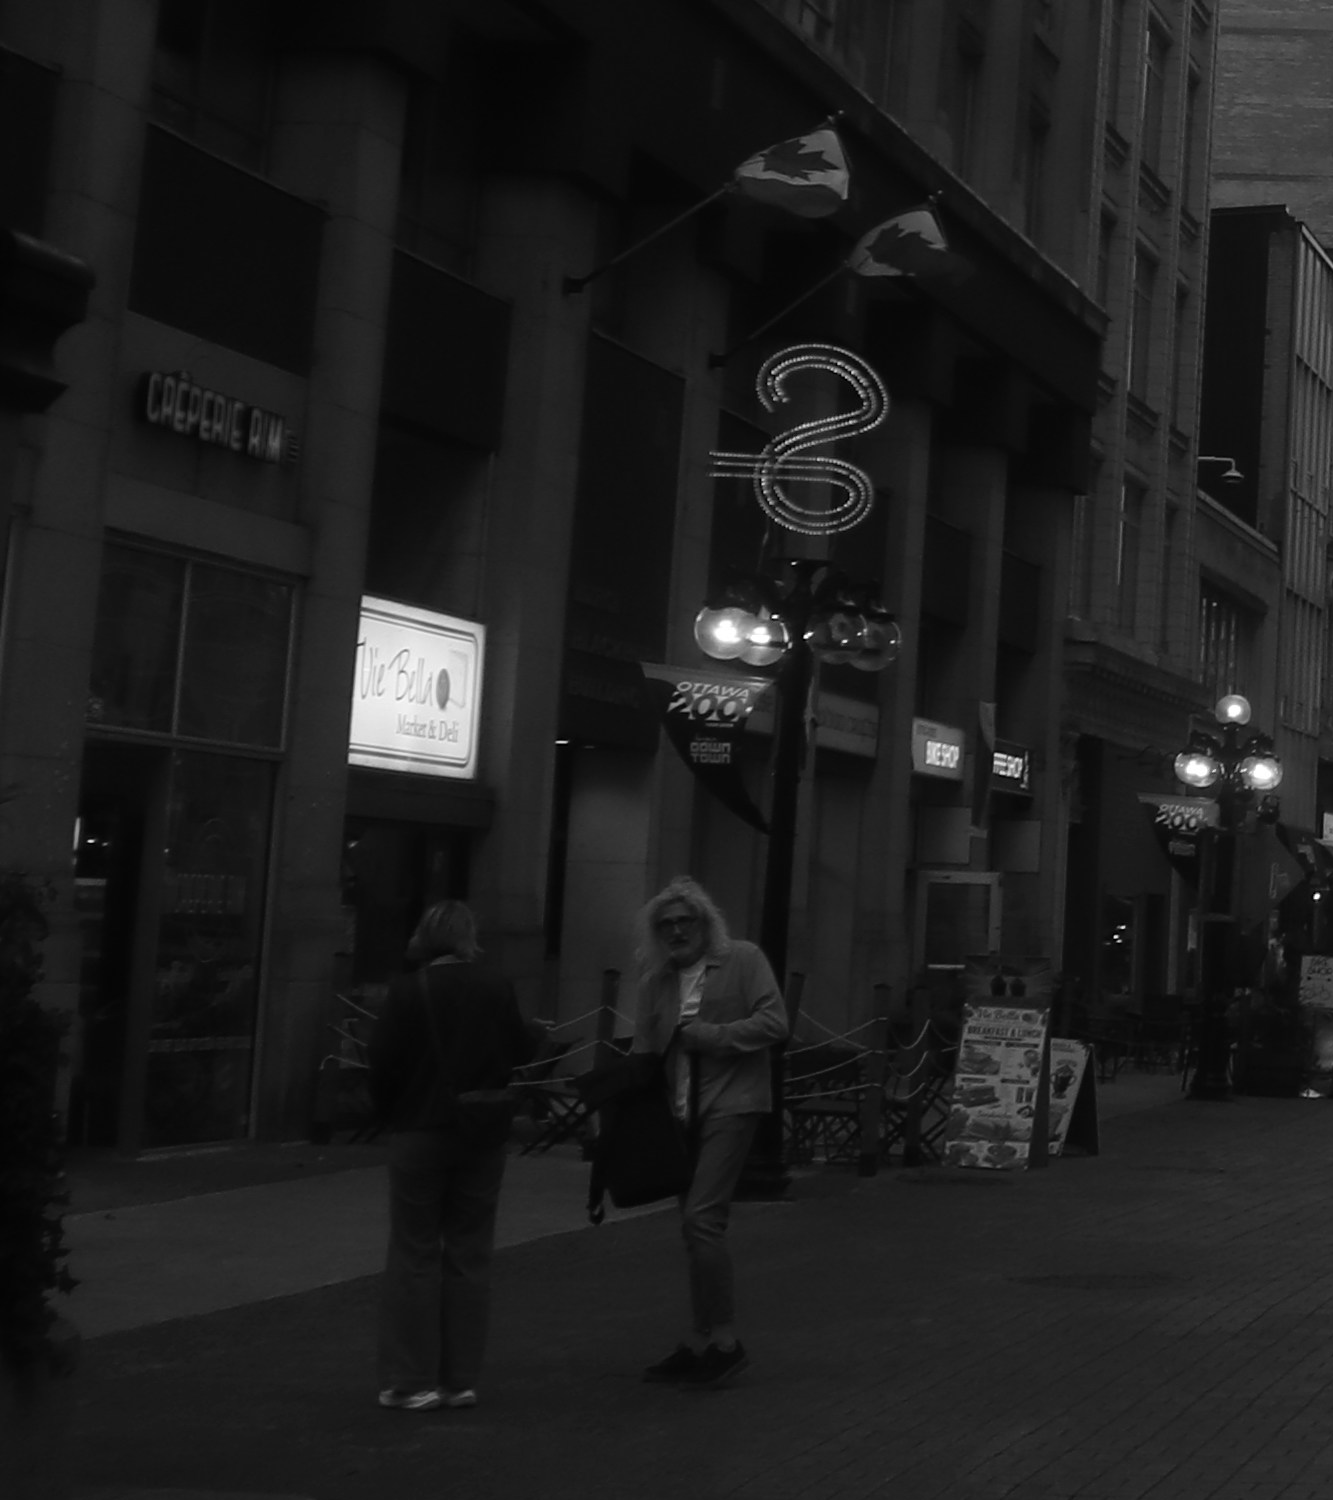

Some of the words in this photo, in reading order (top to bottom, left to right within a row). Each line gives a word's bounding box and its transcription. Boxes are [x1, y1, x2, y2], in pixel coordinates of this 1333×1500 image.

[676, 681, 750, 698] OTTAWA
[396, 713, 427, 738] Market
[427, 720, 437, 739] &
[438, 720, 459, 743] Deli
[690, 741, 731, 752] DOWN
[690, 753, 731, 764] TOWN
